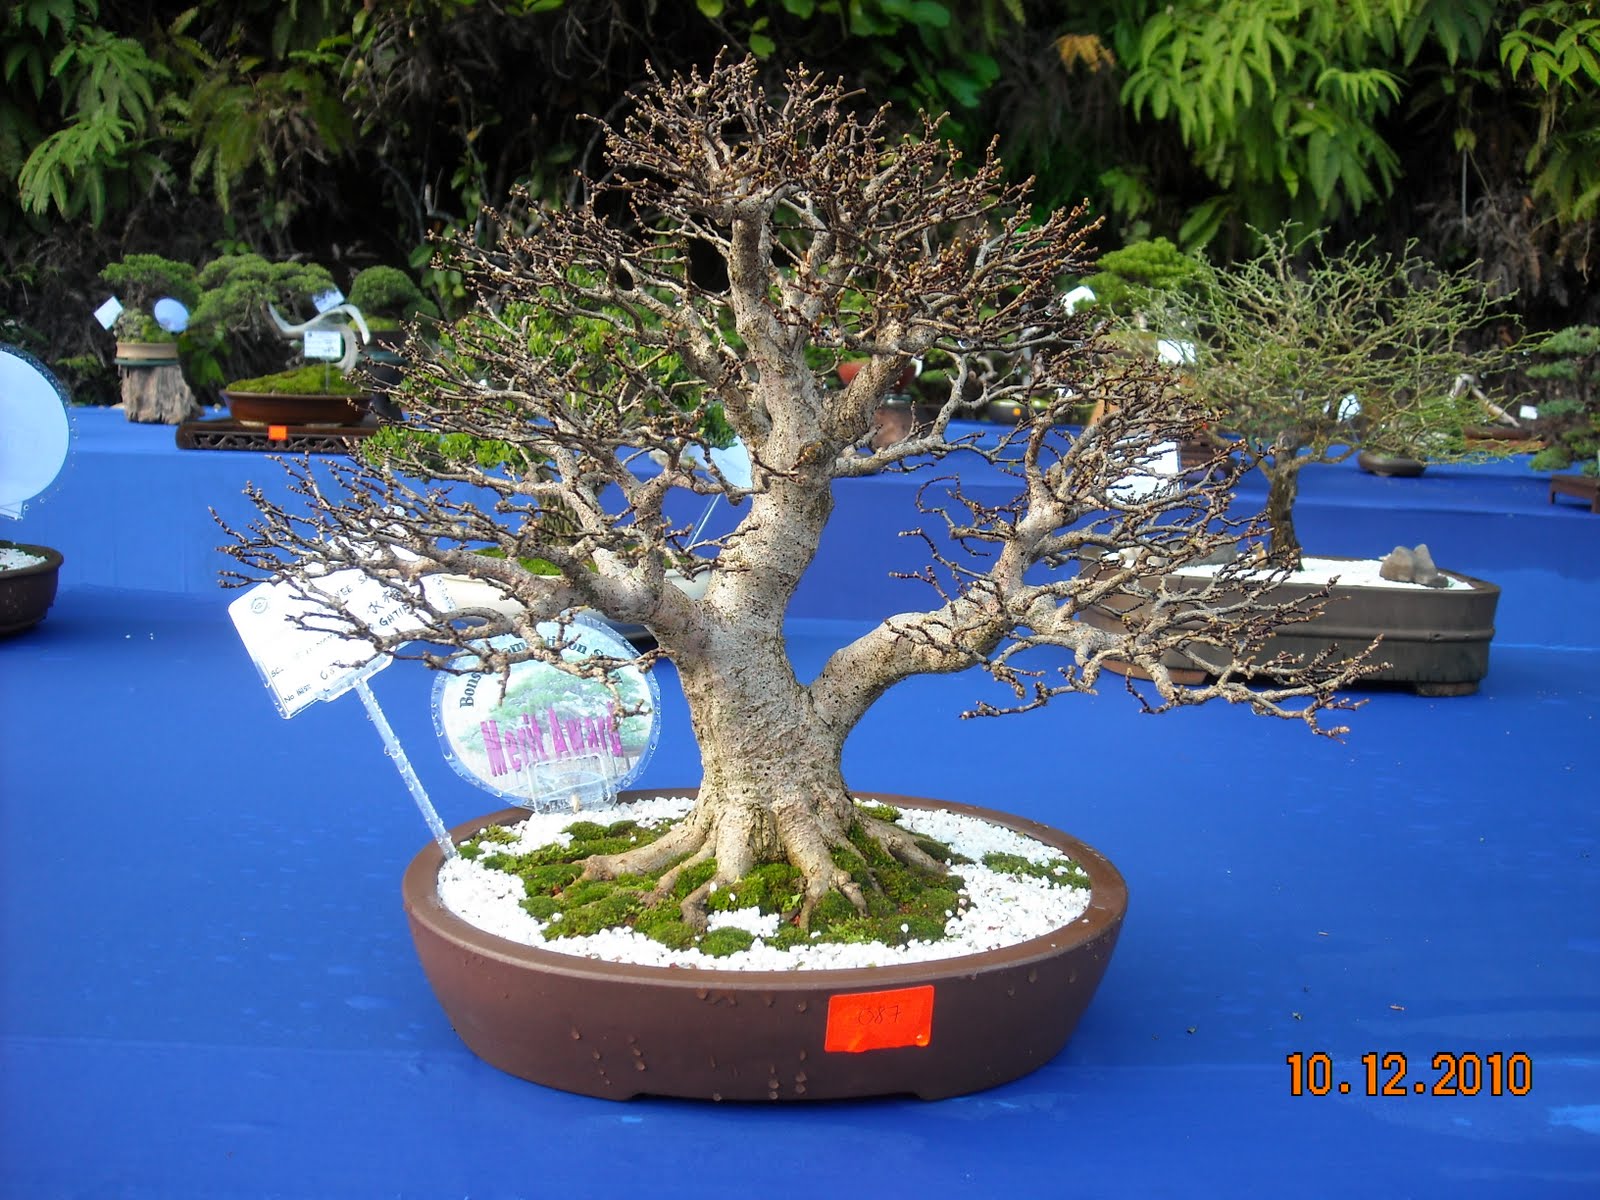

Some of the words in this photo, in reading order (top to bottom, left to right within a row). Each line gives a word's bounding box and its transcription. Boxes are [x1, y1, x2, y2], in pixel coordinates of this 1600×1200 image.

[459, 671, 482, 709] Bons
[480, 712, 547, 777] Merit
[858, 1005, 901, 1025] 087
